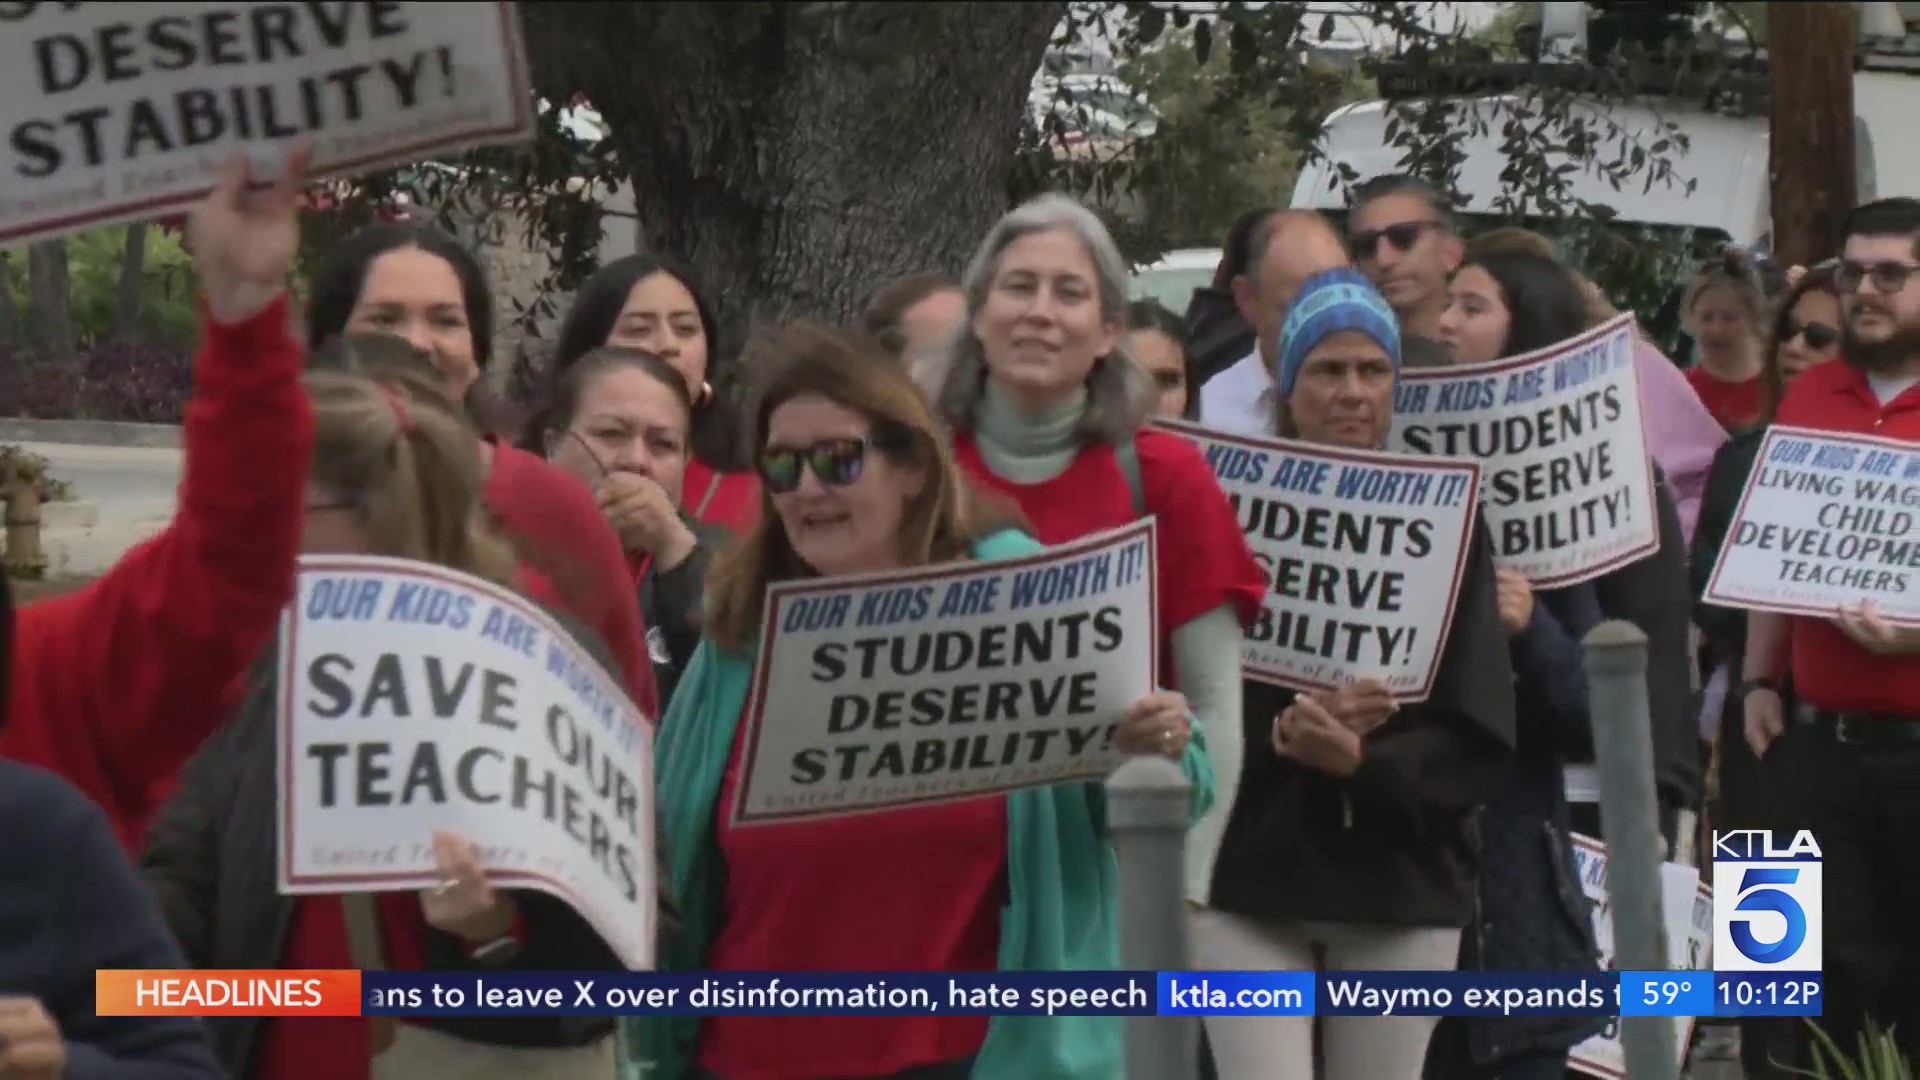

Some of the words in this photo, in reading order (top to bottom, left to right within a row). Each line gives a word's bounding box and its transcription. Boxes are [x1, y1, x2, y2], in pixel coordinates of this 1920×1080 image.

[34, 2, 408, 94] DESERVE
[10, 46, 456, 178] STABILITY!
[1393, 384, 1430, 413] UR
[1435, 376, 1498, 412] KIDS
[1503, 366, 1546, 406] ARE
[1402, 384, 1621, 458] STUDENTS
[1271, 456, 1333, 496] ARE
[1335, 464, 1431, 507] WORTH
[1433, 473, 1470, 508] IT!
[1492, 441, 1613, 507] SERVE
[1758, 467, 1844, 497] LIVING
[1768, 438, 1812, 463] OUR
[1859, 450, 1904, 476] ARE
[1229, 493, 1434, 559] UDENTS
[1502, 485, 1631, 556] BILITY!
[1818, 502, 1912, 536] CHILD
[783, 596, 853, 634] OUR
[855, 587, 934, 627] KIDS
[937, 575, 1003, 617] ARE
[1010, 556, 1109, 607] WORTH
[1115, 540, 1145, 585] IT!
[1778, 559, 1911, 592] TEACHERS
[306, 577, 384, 623] OUR
[386, 582, 476, 631] KIDS
[479, 604, 540, 658] ARE
[811, 606, 1123, 684] STUDENTS
[1243, 606, 1417, 667] BILITY!
[827, 672, 1097, 735] DESERVE
[307, 652, 519, 731] SAVE
[547, 703, 638, 838] OUR
[790, 724, 1117, 786] STABILITY!
[306, 740, 638, 904] TEACHERS
